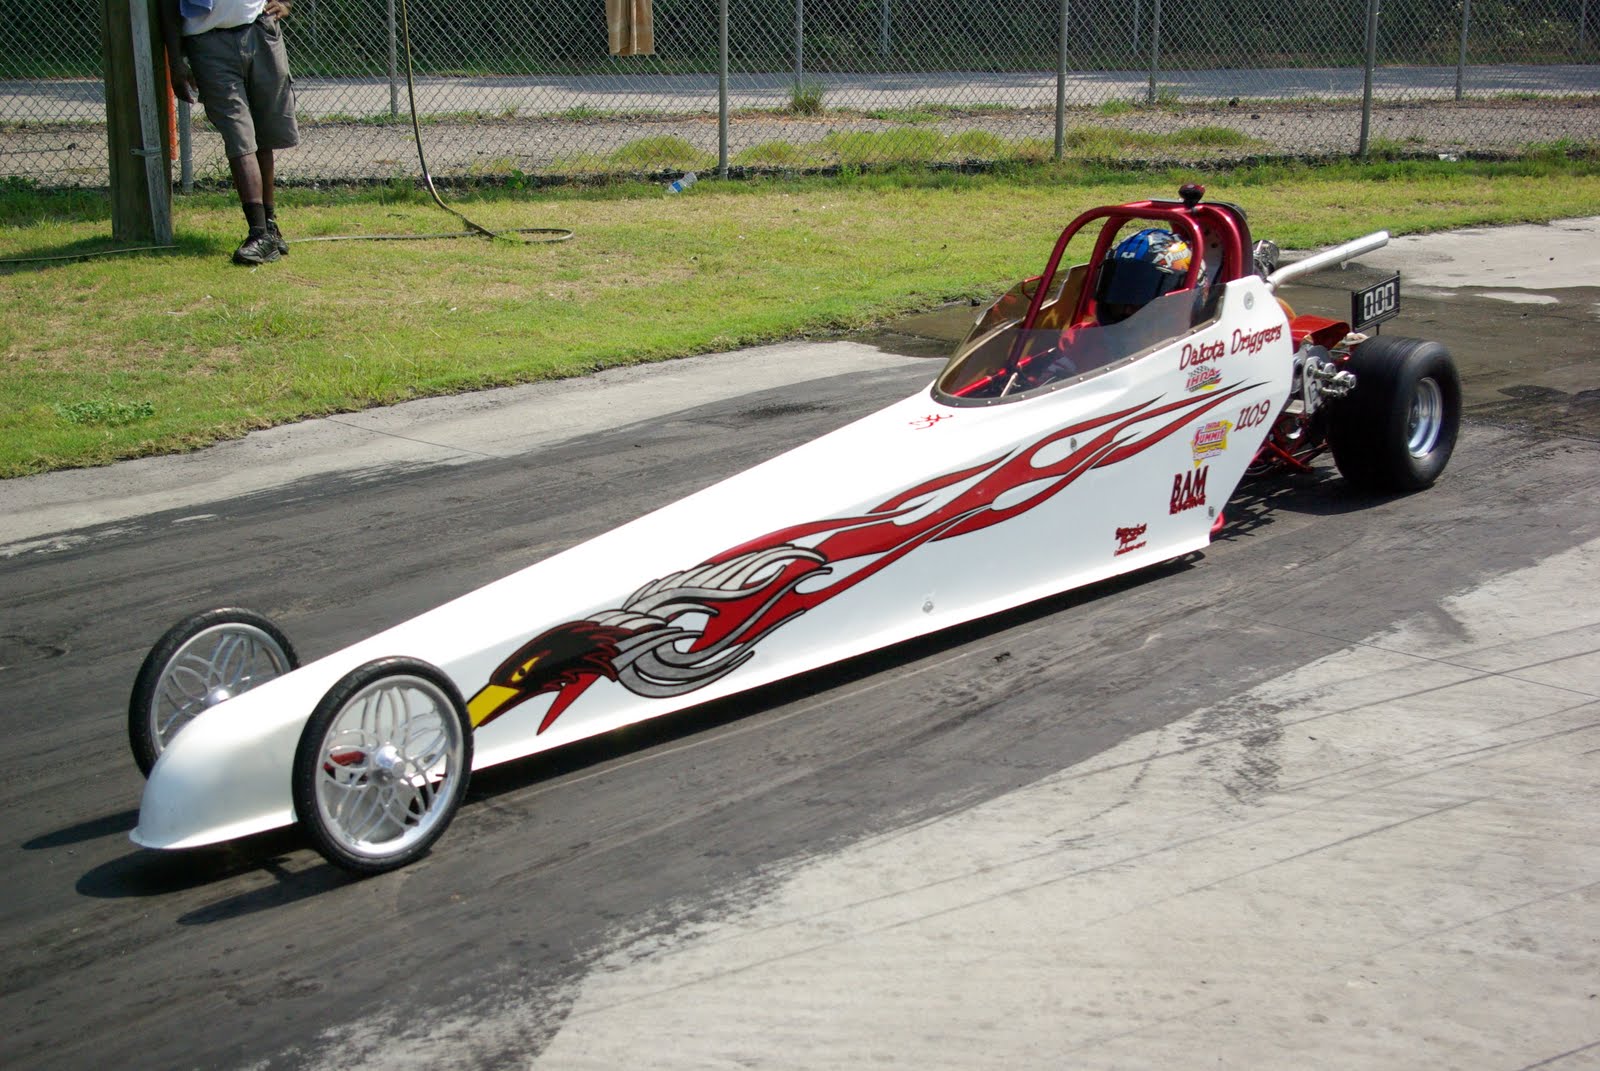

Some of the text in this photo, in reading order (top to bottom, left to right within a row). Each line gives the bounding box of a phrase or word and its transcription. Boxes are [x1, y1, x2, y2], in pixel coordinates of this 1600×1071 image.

[1363, 282, 1395, 321] 0.00
[1179, 324, 1283, 371] Dakota Driggers
[1185, 367, 1217, 389] IHRA
[1234, 399, 1271, 432] 1109
[1170, 465, 1209, 505] BAM
